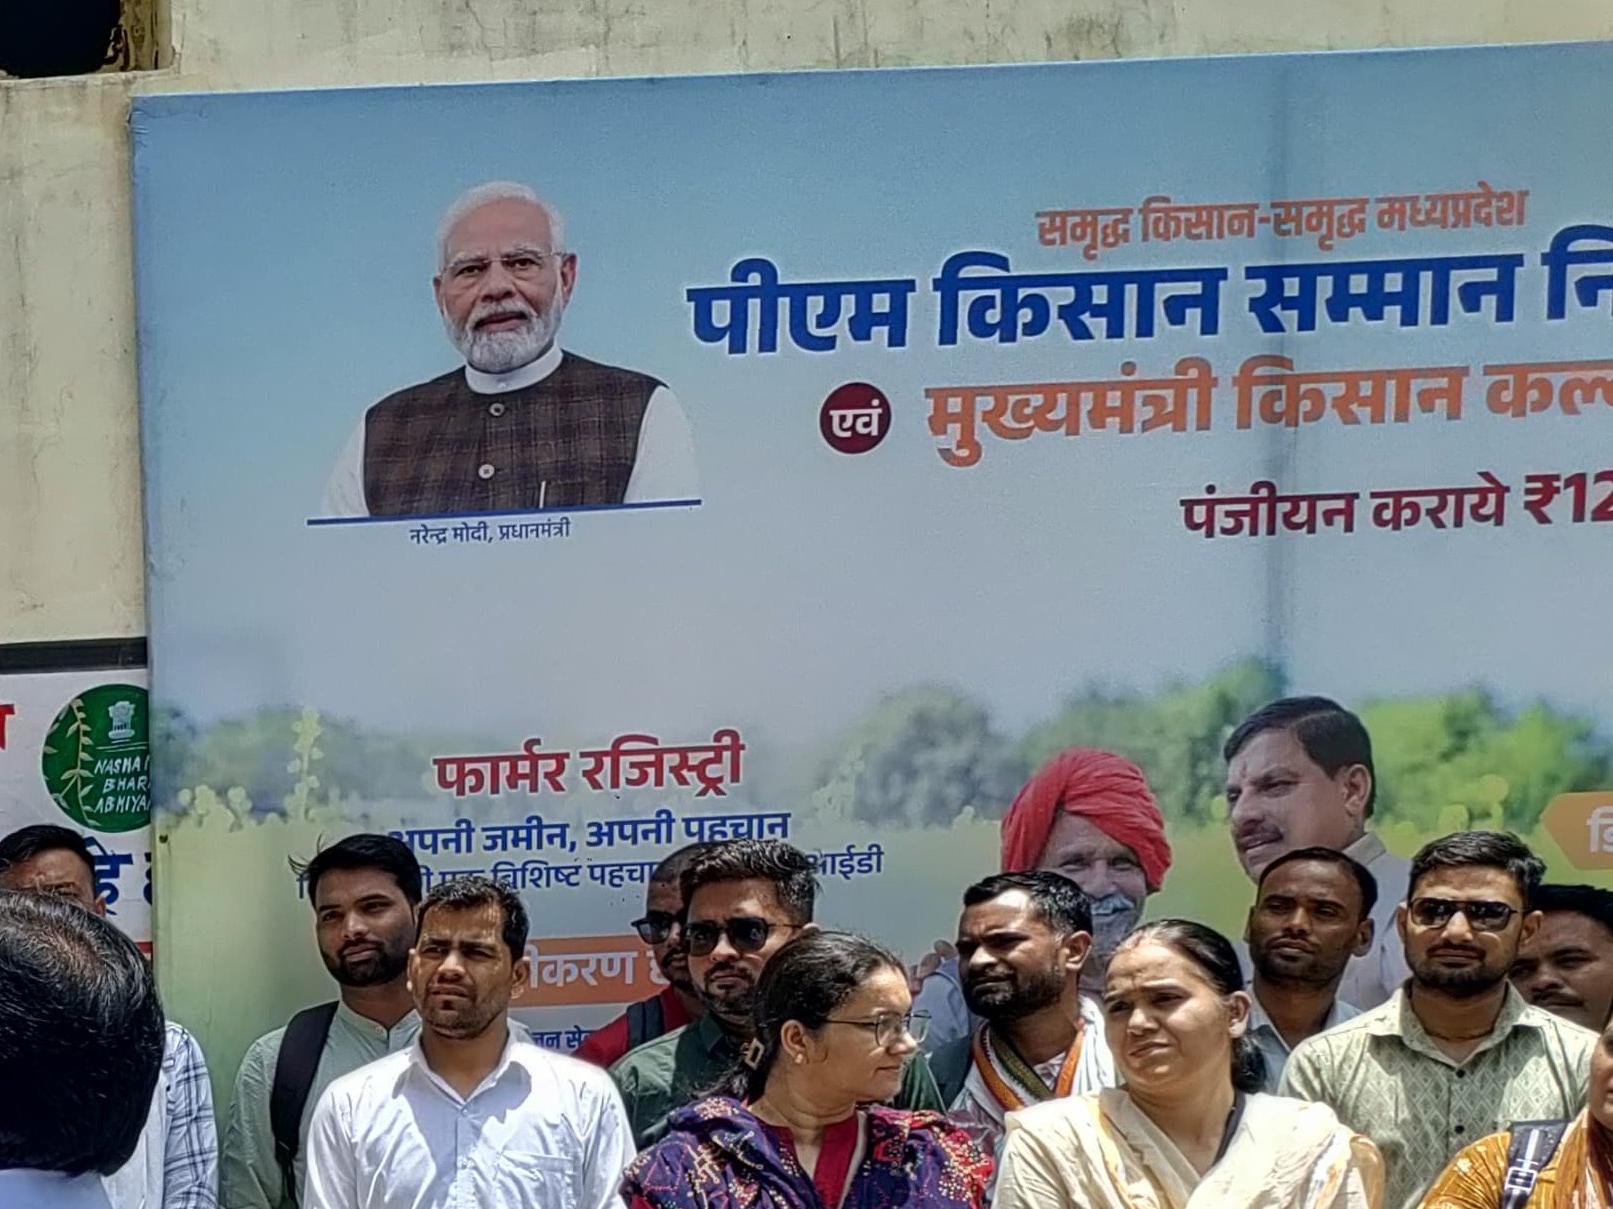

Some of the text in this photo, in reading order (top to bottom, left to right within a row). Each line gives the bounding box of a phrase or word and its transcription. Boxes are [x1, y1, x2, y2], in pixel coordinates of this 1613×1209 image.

[1035, 205, 1131, 261] समृद्ध
[1375, 181, 1530, 231] मध्यप्रदेश
[686, 258, 916, 355] पीएम
[933, 250, 1228, 347] किसान
[1244, 253, 1525, 333] सम्मान
[830, 398, 882, 438] एवं
[925, 356, 1219, 468] मुख्यमंत्री
[1232, 353, 1470, 432] किसान
[1180, 470, 1613, 539] पंजीयन कराये ₹12
[409, 516, 571, 545] नरेन्द्र मोदी, प्रधानमंत्री
[102, 774, 151, 794] BHAR
[433, 728, 746, 799] फार्मर रजिस्ट्री
[481, 814, 578, 853] जमीन,
[585, 808, 677, 847] अपनी
[588, 860, 658, 888] पहचा
[524, 944, 638, 989] ीकरण
